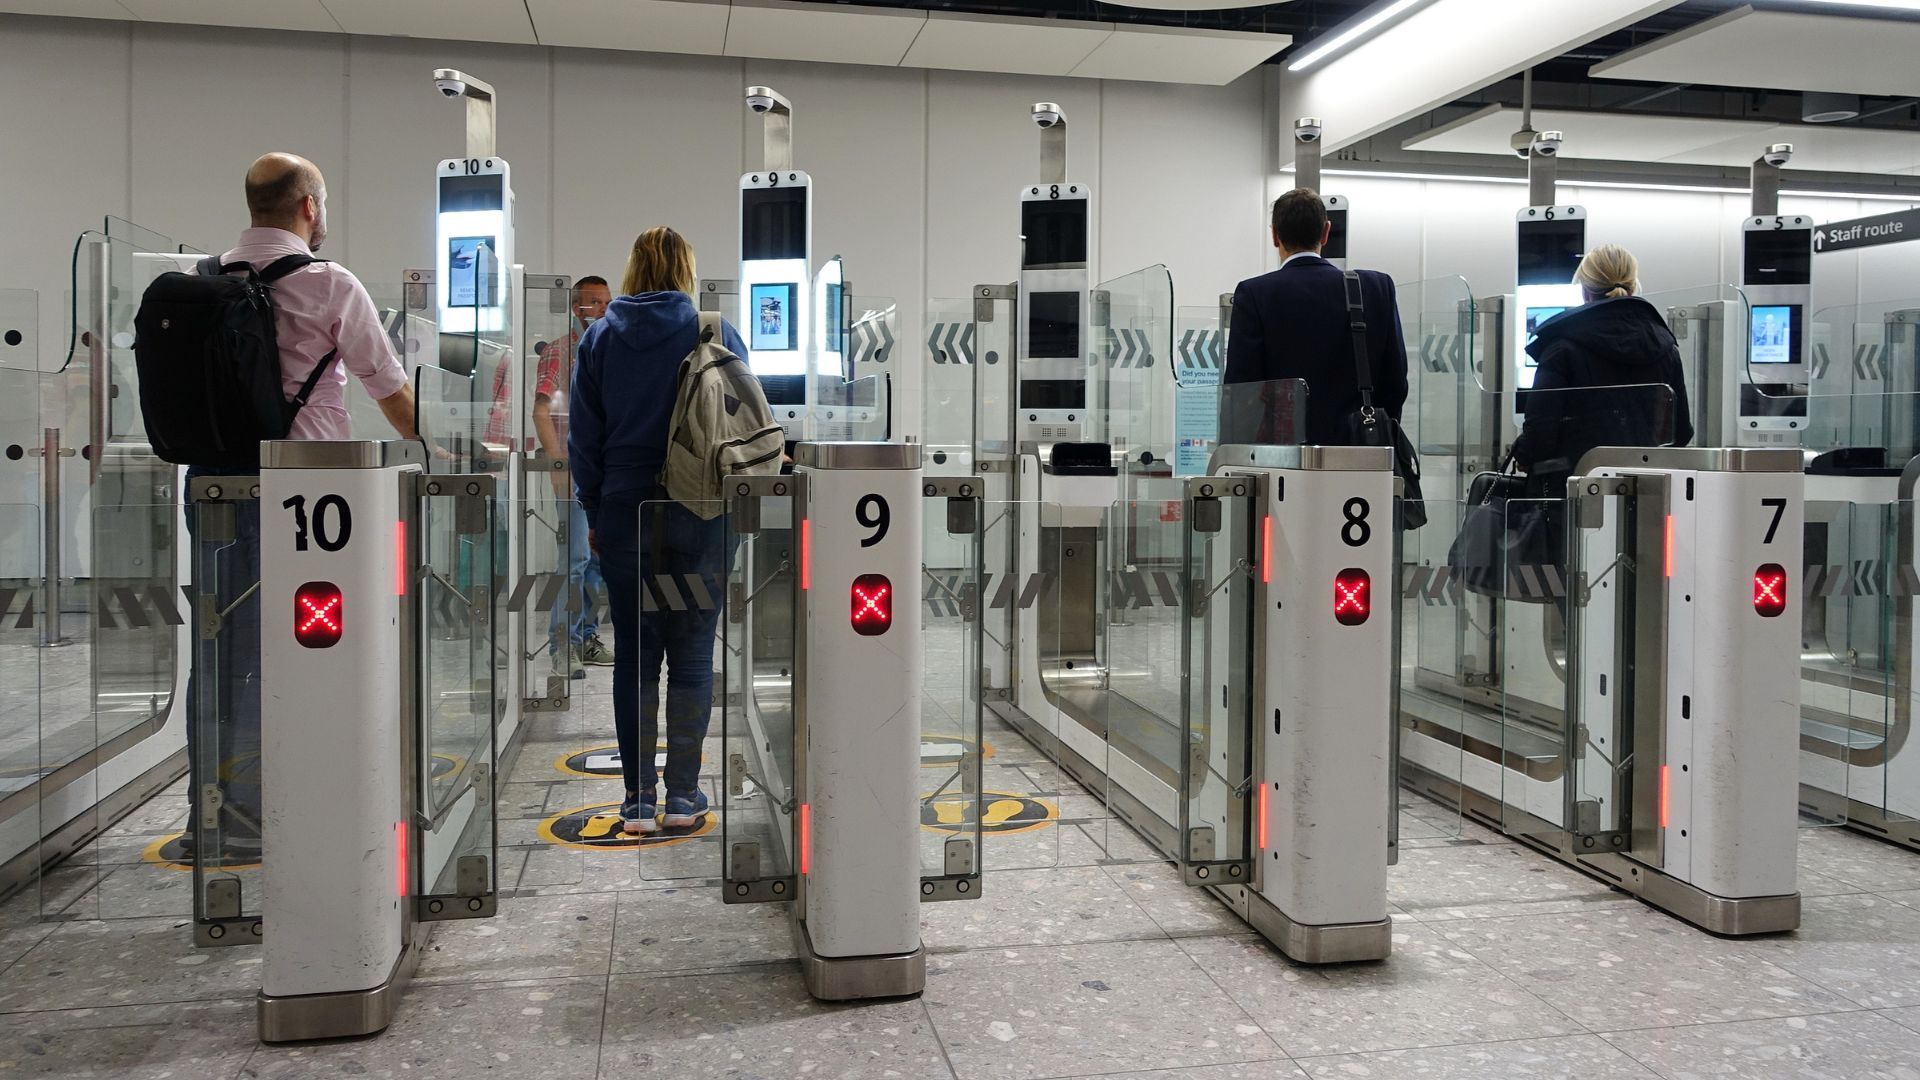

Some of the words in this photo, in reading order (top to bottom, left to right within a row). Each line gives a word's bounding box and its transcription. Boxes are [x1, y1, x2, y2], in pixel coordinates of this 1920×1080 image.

[462, 159, 480, 175] 10
[768, 172, 778, 188] 9
[1050, 184, 1060, 200] 8
[1545, 206, 1555, 221] 6
[1774, 216, 1784, 231] 5
[1830, 225, 1862, 243] Staff
[1865, 221, 1903, 238] route
[282, 493, 353, 553] 10
[855, 493, 891, 548] 9
[1340, 496, 1371, 548] 8
[1761, 498, 1787, 545] 7
